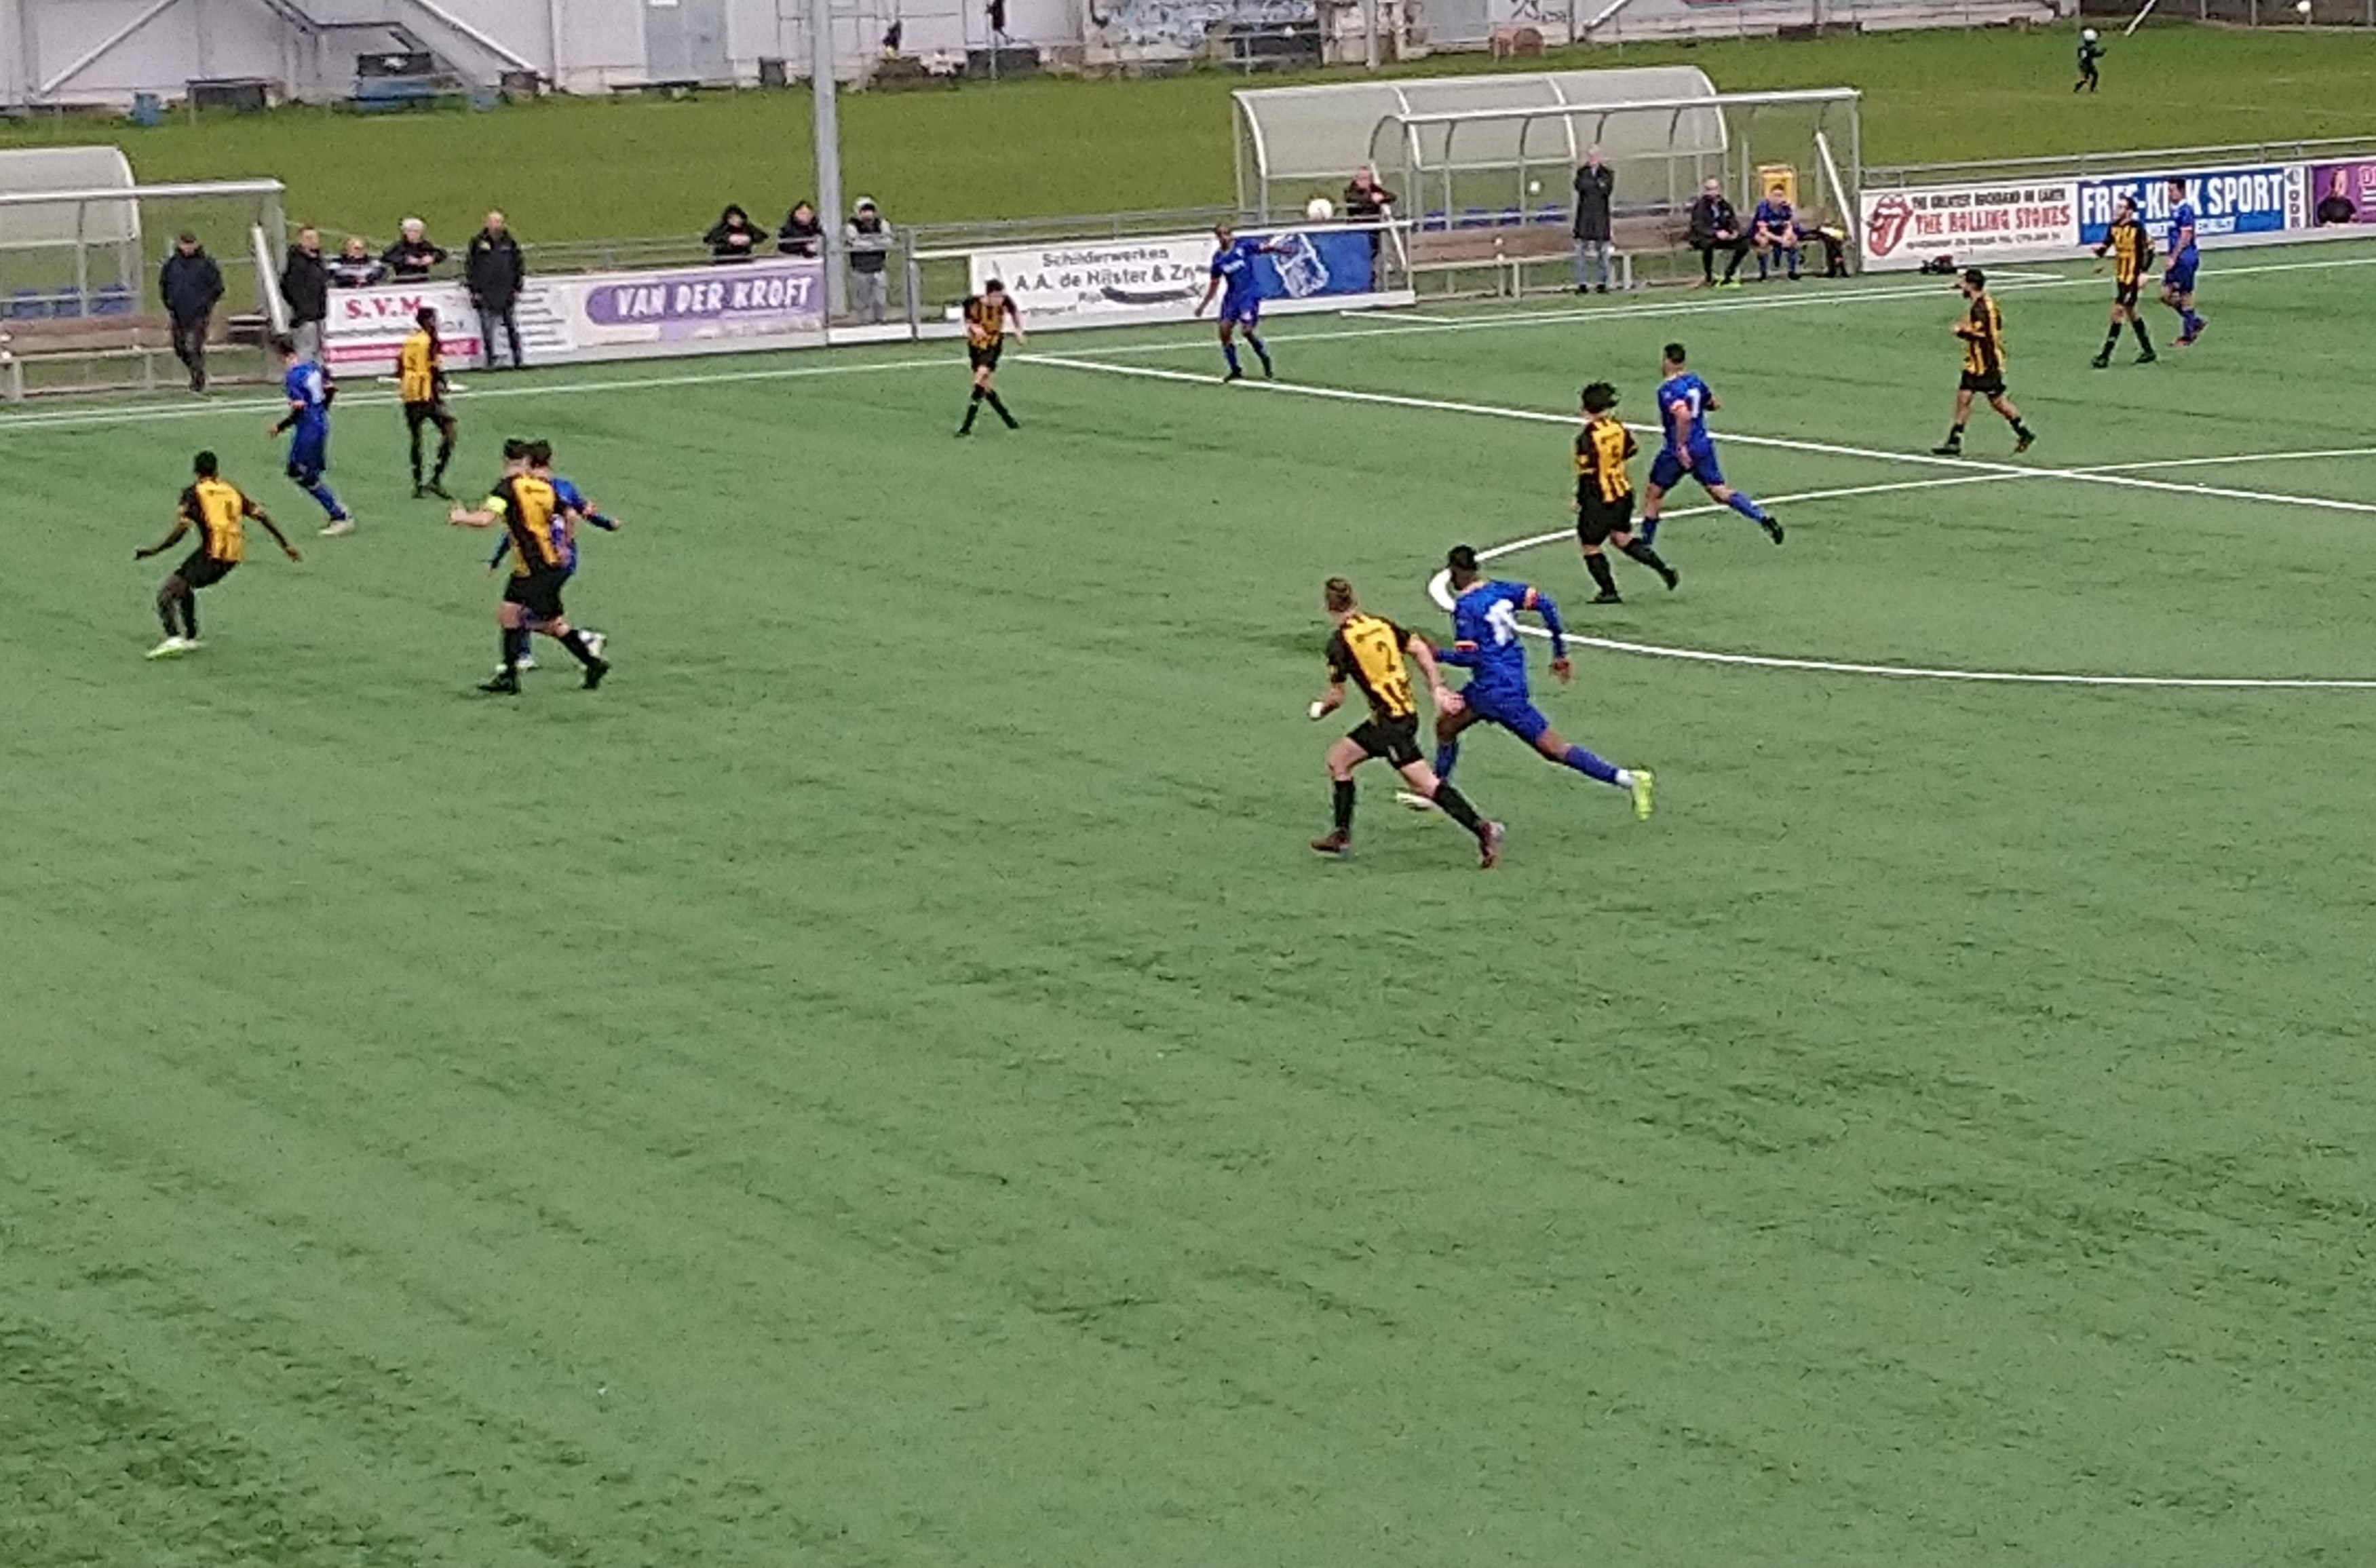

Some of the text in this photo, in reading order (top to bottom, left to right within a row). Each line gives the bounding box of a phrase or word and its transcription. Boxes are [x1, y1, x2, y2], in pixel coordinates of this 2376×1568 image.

[2082, 174, 2283, 224] FRE-KIK SPORT
[1915, 204, 2071, 235] THE ROLLING STONES
[1059, 272, 1081, 288] de
[1151, 264, 1164, 283] &
[615, 276, 813, 318] VAN DER KROFT
